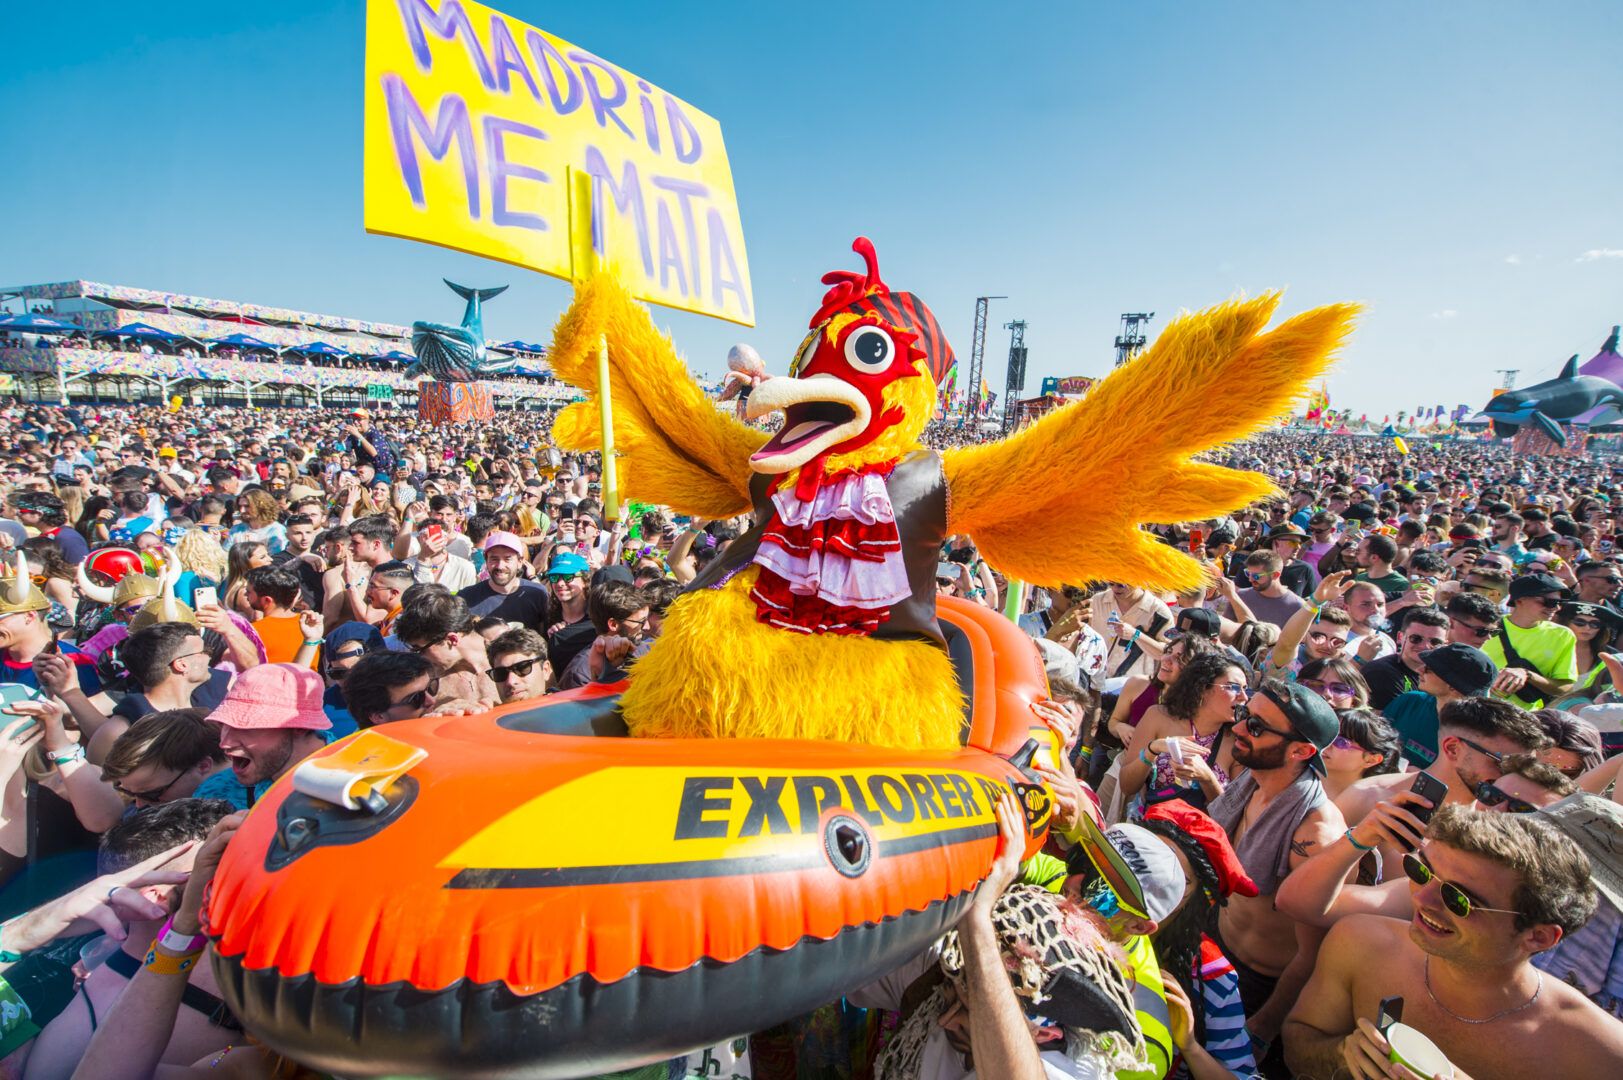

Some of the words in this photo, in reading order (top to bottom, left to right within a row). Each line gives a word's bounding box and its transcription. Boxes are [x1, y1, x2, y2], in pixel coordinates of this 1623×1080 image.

[380, 73, 550, 231] ME
[585, 144, 749, 316] MATA
[368, 384, 393, 398] BAR
[674, 773, 982, 840] EXPLORER
[1106, 830, 1152, 874] ELROW
